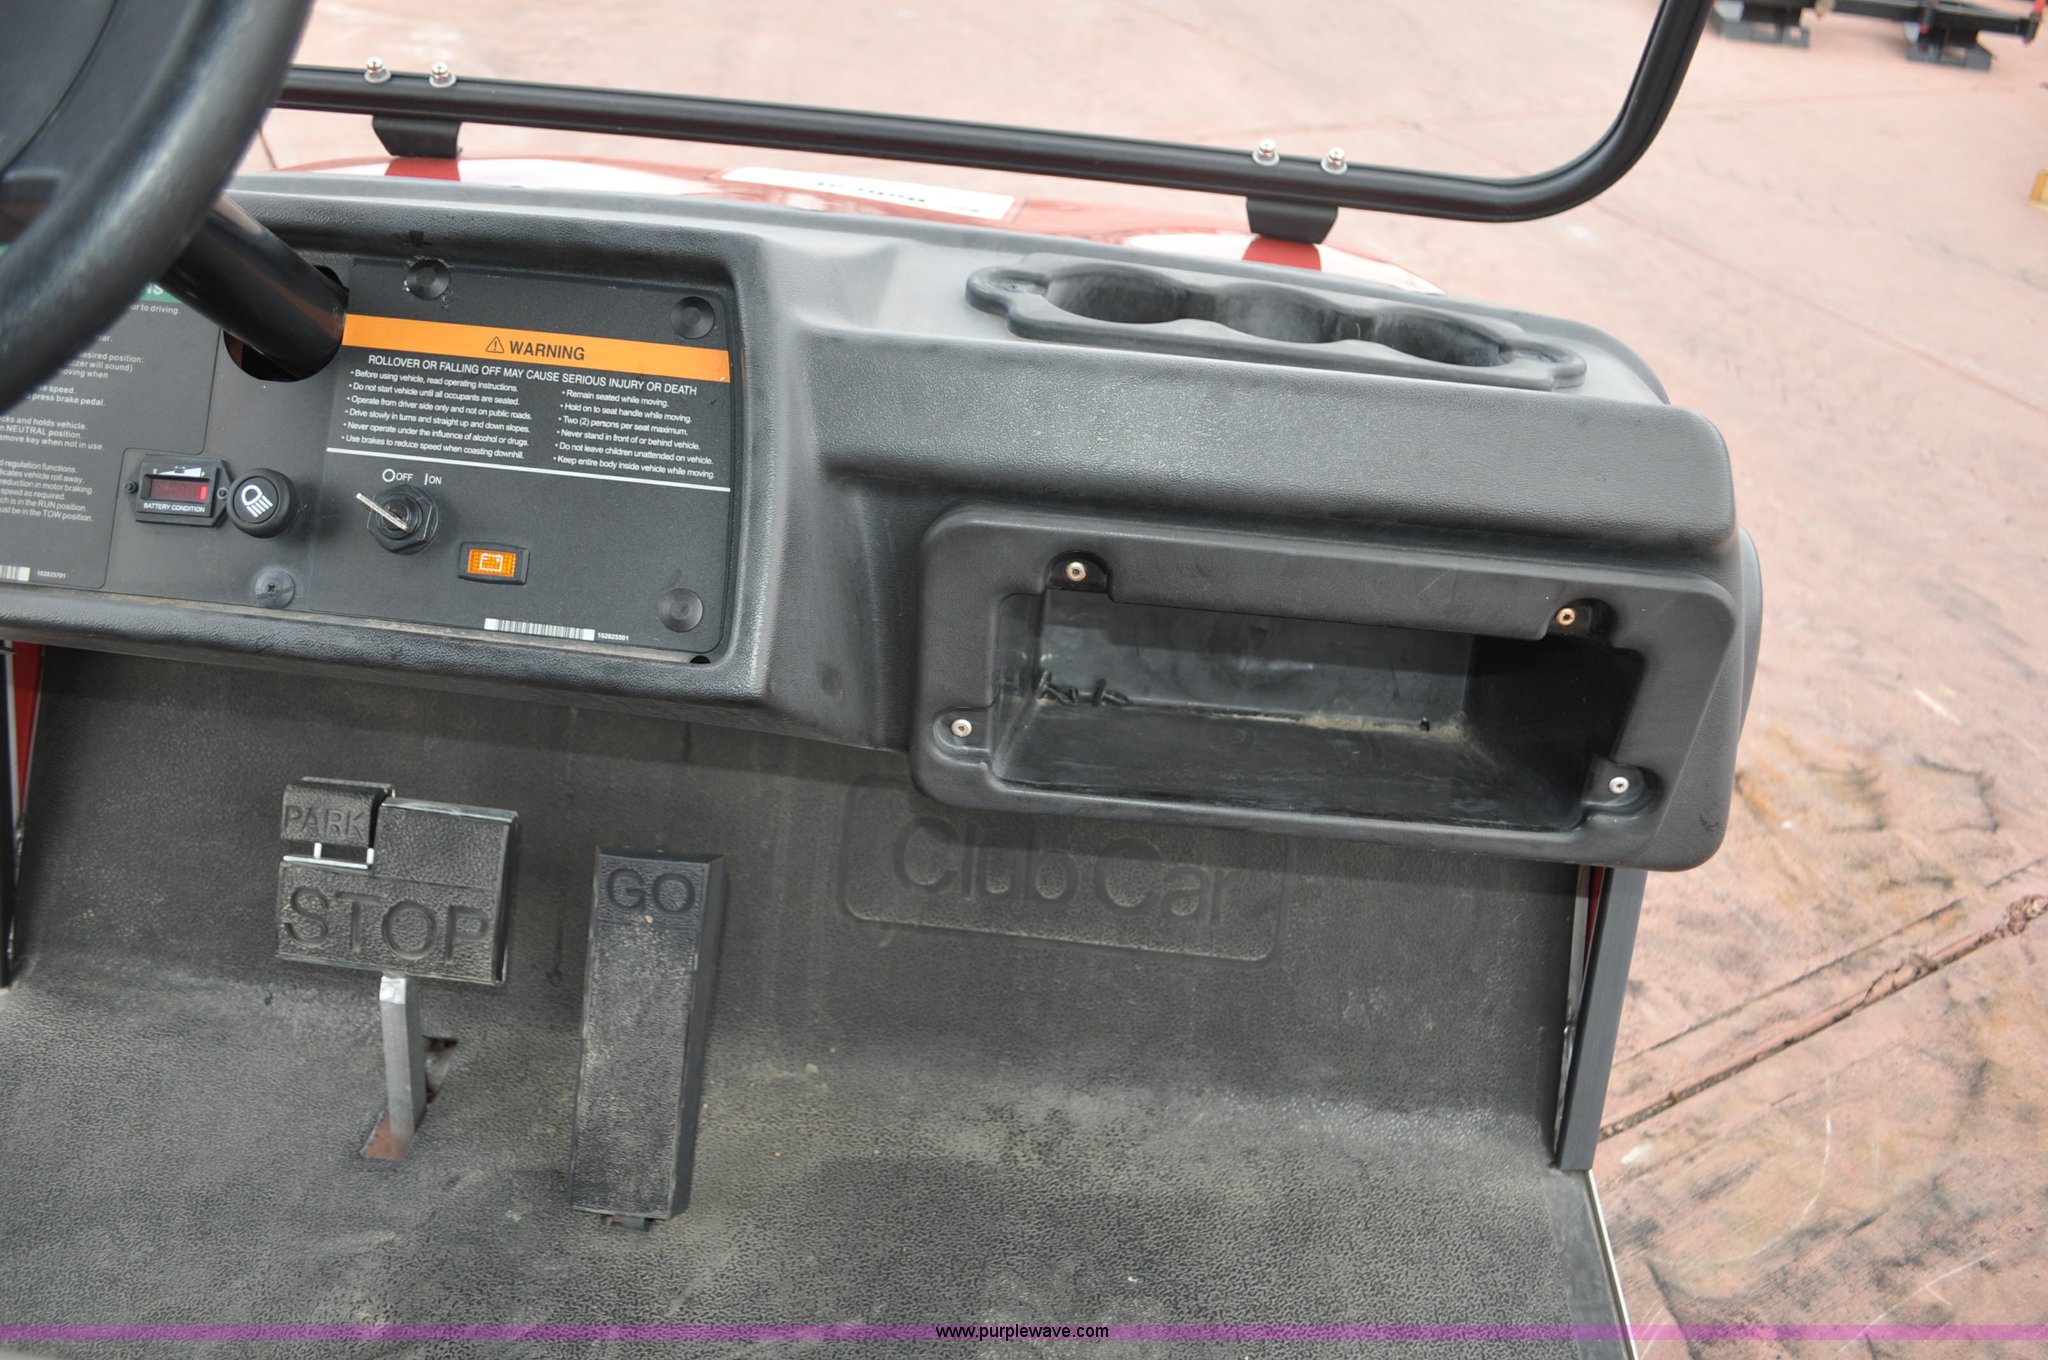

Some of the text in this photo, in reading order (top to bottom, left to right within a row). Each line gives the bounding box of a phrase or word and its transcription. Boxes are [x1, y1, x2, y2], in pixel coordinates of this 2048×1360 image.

[509, 340, 585, 361] WARNING
[355, 368, 518, 392] Before using vehicle, read operating instructions.
[368, 357, 697, 394] ROLLOVER OR FALLING OFF MAY CAUSE SERIOUS INJURY OR DEATH
[353, 381, 364, 390] Do
[378, 384, 393, 393] start
[394, 386, 418, 395] vehicle
[419, 389, 434, 397] until
[435, 390, 443, 398] all
[444, 392, 480, 402] occupants
[494, 397, 520, 406] seated.
[566, 389, 669, 409] Remain seated while moving.
[351, 394, 380, 405] Operate
[380, 397, 397, 406] from
[398, 399, 417, 409] driver
[419, 401, 433, 410] side
[435, 403, 449, 414] only
[450, 405, 464, 413] and
[465, 407, 477, 415] not
[488, 409, 509, 418] public
[510, 411, 532, 420] roads.
[564, 402, 582, 411] Hold
[593, 405, 600, 413] to
[618, 407, 643, 418] handle
[644, 410, 663, 420] while
[664, 413, 692, 424] moving.
[349, 407, 530, 434] Drive slowly in turns and straight up and down slopes.
[564, 415, 688, 436] Two (2) persons per seat maximum.
[346, 433, 524, 459] Use brakes to reduce speed when coasting downhill.
[347, 420, 368, 430] Never
[370, 425, 396, 433] operate
[398, 426, 418, 435] under
[419, 428, 430, 436] the
[432, 429, 463, 440] influence
[464, 432, 472, 440] of
[473, 433, 498, 443] alcohol
[507, 436, 529, 448] drugs.
[561, 428, 582, 438] Never
[584, 431, 604, 440] stand
[605, 432, 612, 441] in
[613, 433, 629, 443] front
[630, 435, 638, 444] of
[648, 437, 673, 447] behind
[674, 440, 700, 450] vehicle.
[559, 441, 570, 450] Do
[584, 444, 603, 453] leave
[605, 446, 633, 456] children
[634, 451, 675, 461] unattended
[687, 455, 713, 465] vehicle.
[396, 472, 413, 481] OFF
[429, 475, 442, 484] ON
[558, 454, 715, 480] Keep entire body inside vehicle while moving.
[285, 804, 367, 841] PARK
[894, 816, 1242, 925] Club Car
[607, 868, 696, 913] GO
[284, 885, 489, 963] STOP
